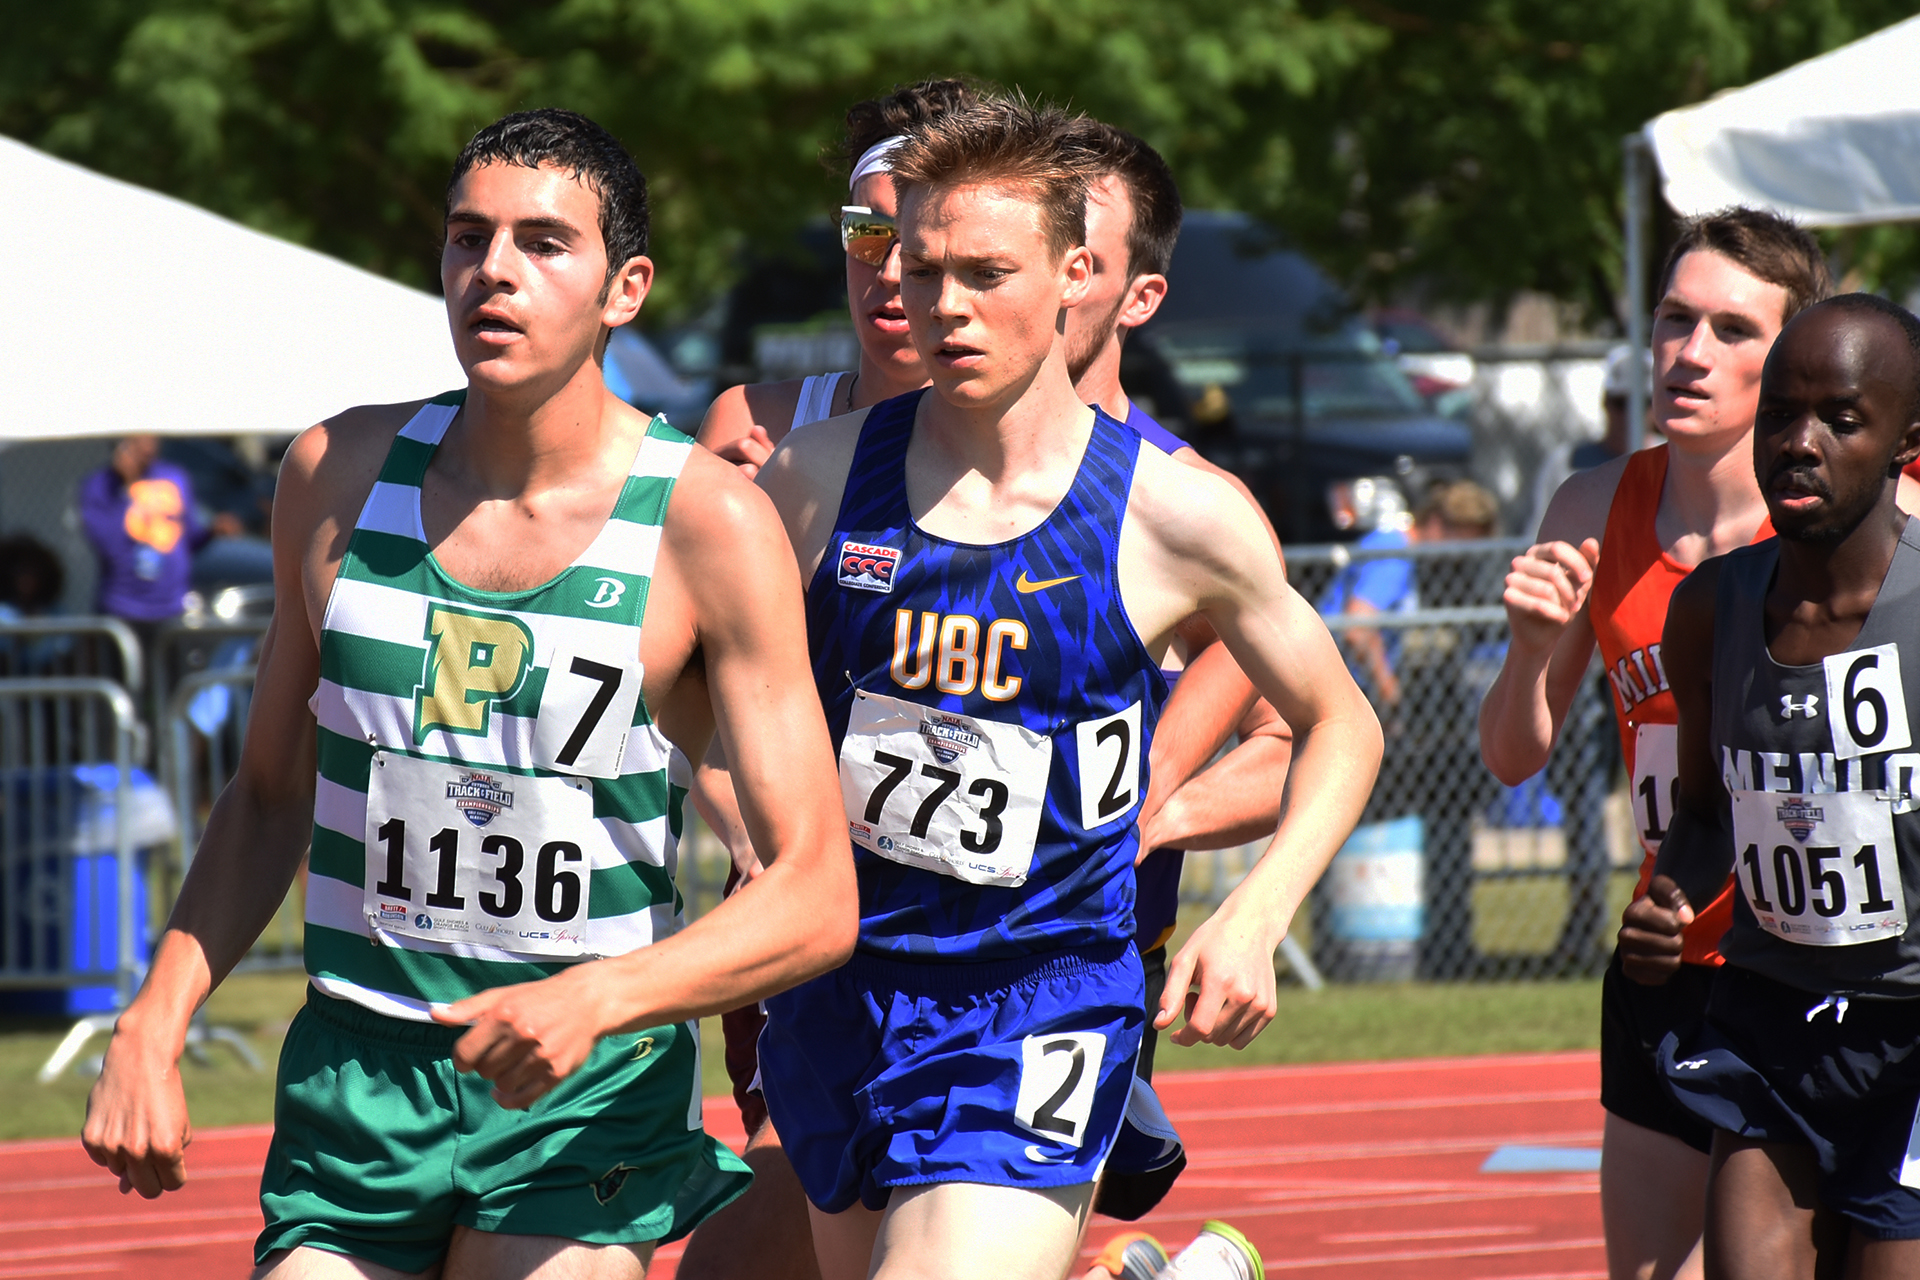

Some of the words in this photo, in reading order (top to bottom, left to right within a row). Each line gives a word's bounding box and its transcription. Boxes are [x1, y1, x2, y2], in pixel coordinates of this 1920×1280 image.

[842, 555, 894, 578] CCC
[844, 543, 899, 558] CASCADE
[413, 600, 534, 746] P
[890, 608, 1028, 701] UBC
[554, 655, 624, 767] 7
[921, 722, 950, 738] TRACK
[953, 730, 980, 748] FIELD
[1843, 654, 1889, 748] 6
[448, 783, 480, 797] TRACK
[485, 789, 512, 806] FIELD
[864, 750, 1009, 854] 773
[1096, 718, 1132, 819] 2
[457, 801, 500, 813] CHAMPIONSHIPS
[1639, 775, 1680, 840] 1
[376, 817, 583, 923] 1136
[968, 862, 996, 873] UCS
[1743, 843, 1895, 918] 1051
[519, 931, 549, 939] UCS
[1032, 1039, 1085, 1137] 2
